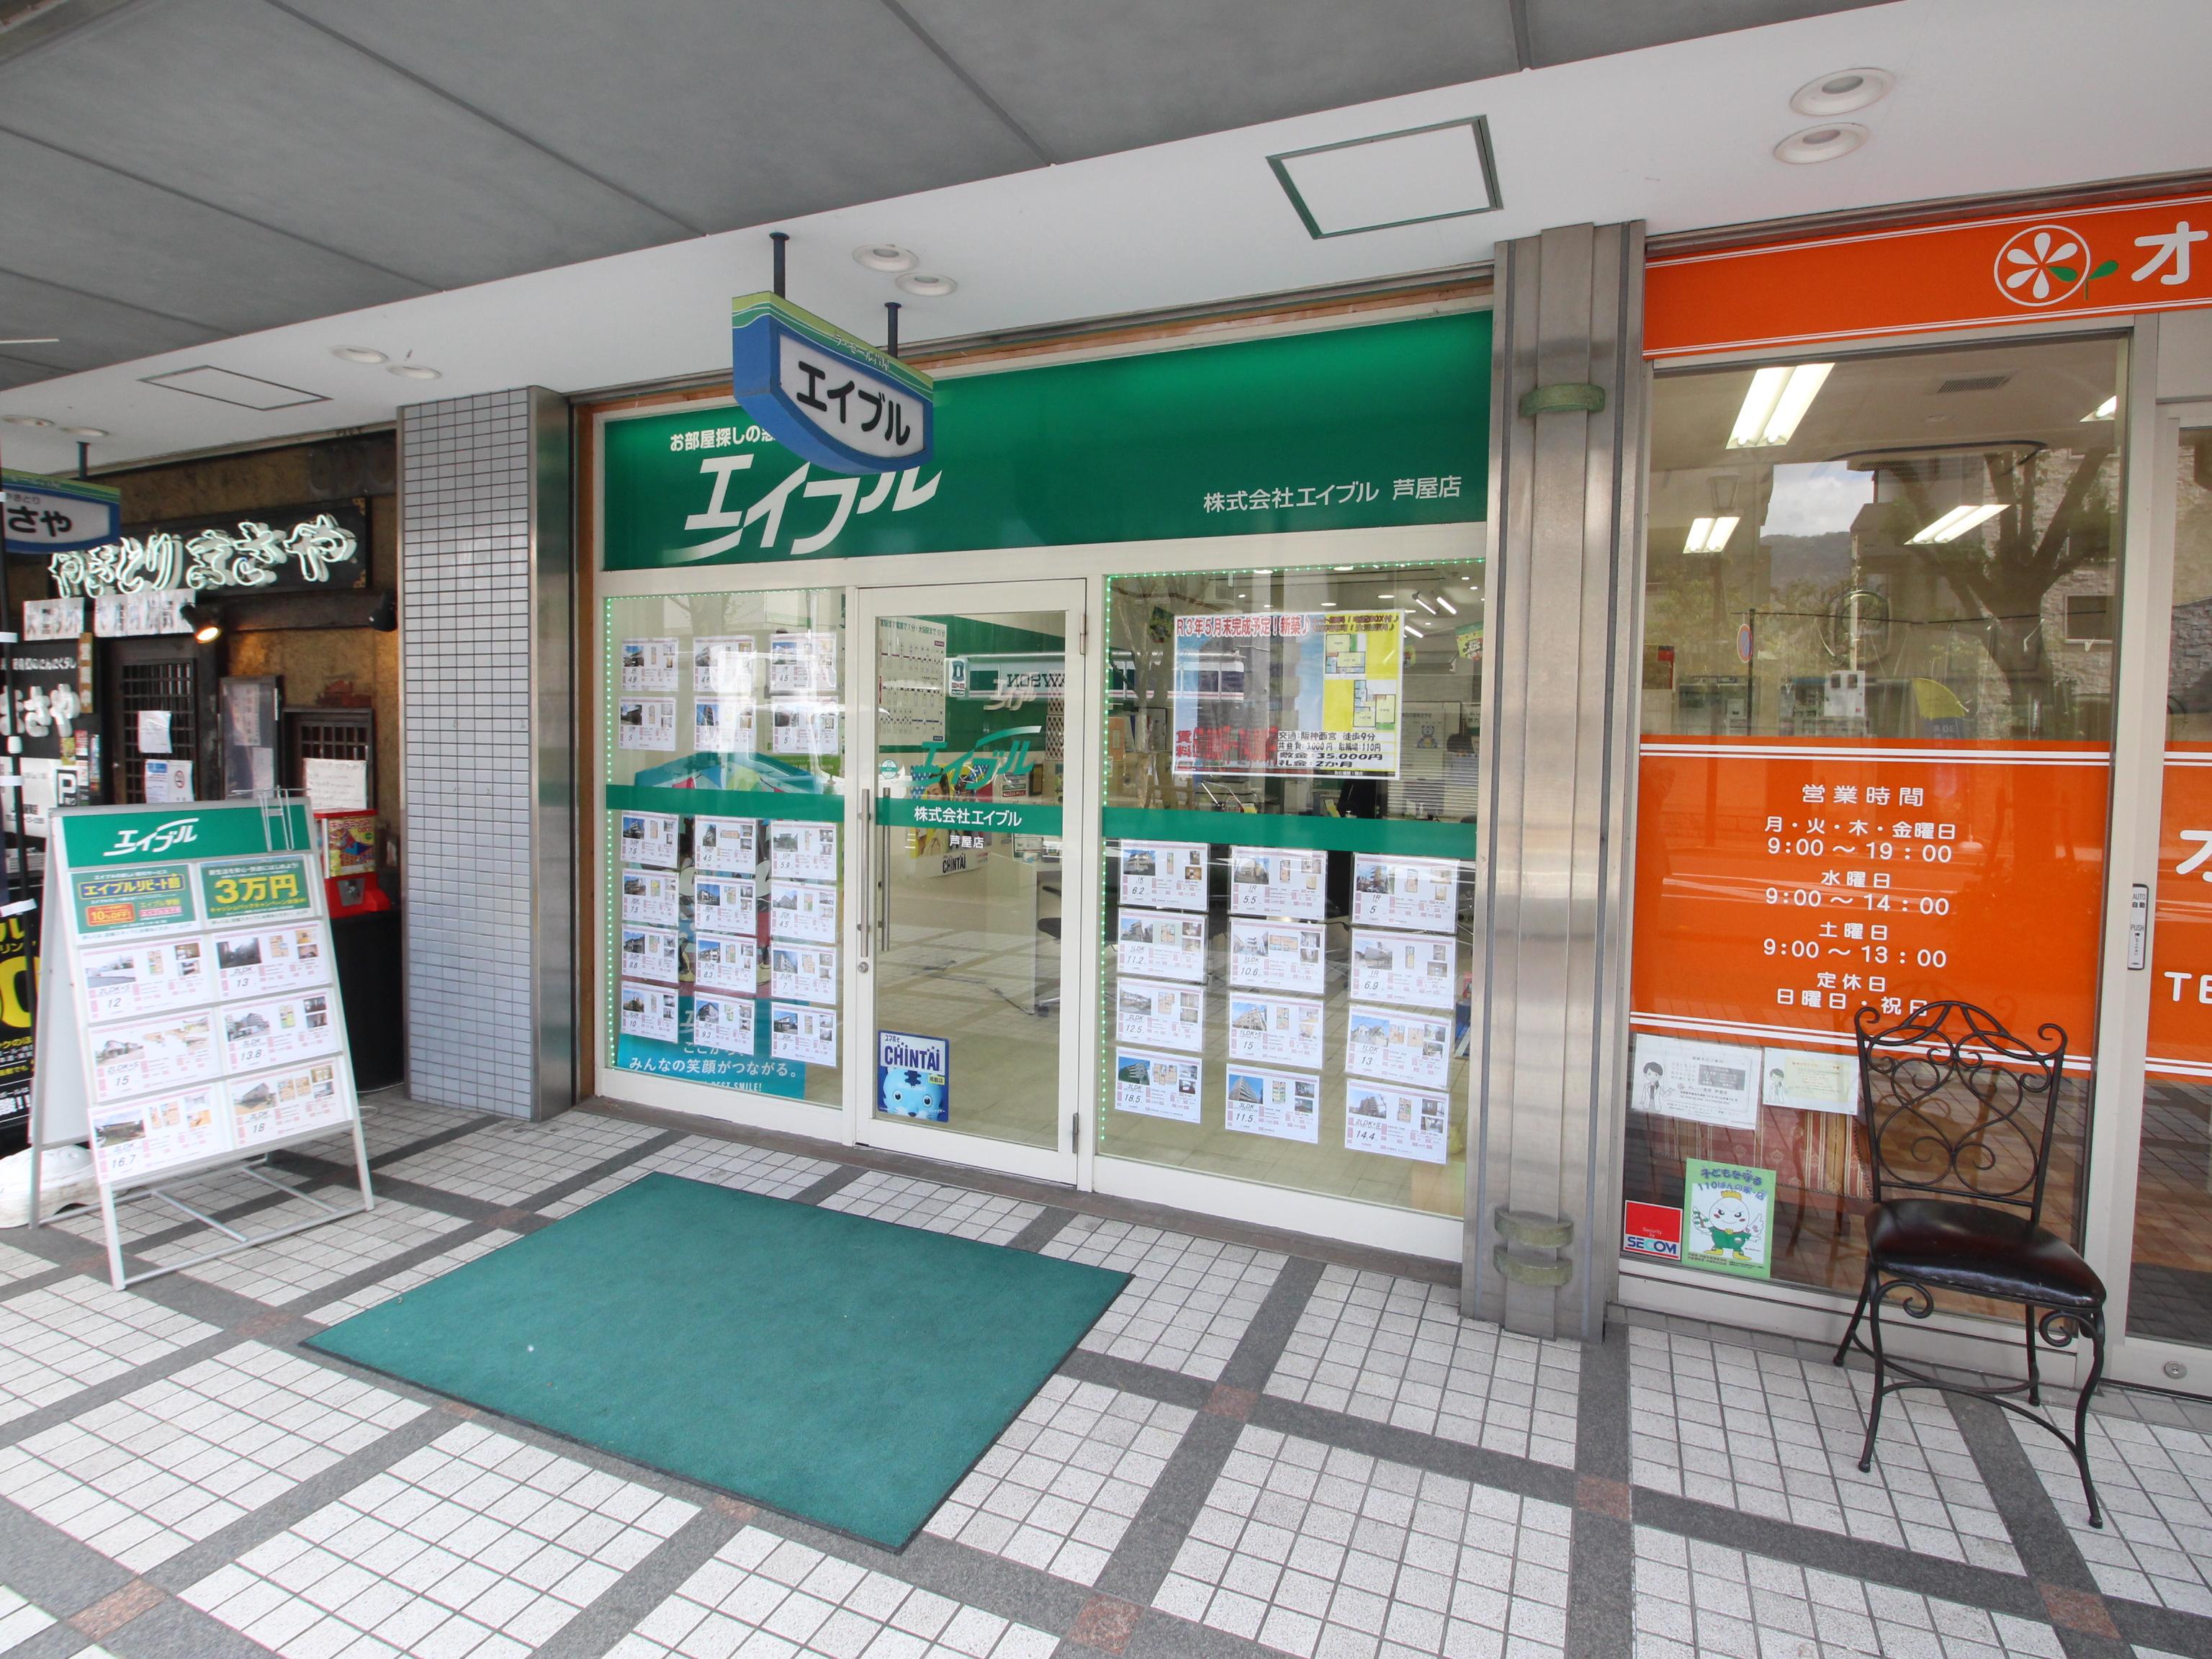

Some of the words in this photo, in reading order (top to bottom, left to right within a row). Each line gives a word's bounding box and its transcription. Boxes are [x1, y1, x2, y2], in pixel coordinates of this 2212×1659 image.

[2131, 221, 2208, 285] オ
[797, 360, 910, 446] エイブル
[1203, 481, 1380, 513] 株式会社エイブル
[1393, 475, 1462, 500] 芦屋店
[899, 725, 1042, 789] エイブル
[1802, 784, 1923, 807] 営業時間
[914, 806, 1022, 827] 株式会社エイブル
[1764, 816, 1956, 840] 月・火・木・金曜日
[102, 818, 199, 857] エイブル
[949, 835, 984, 849] 芦屋店
[943, 854, 966, 873] CHINTAI
[1821, 870, 1890, 888] 水曜日
[215, 873, 298, 904] 3万円
[1132, 886, 1145, 895] 6.2
[1243, 895, 1256, 904] 5.5
[1370, 905, 1377, 914] 5
[1819, 922, 1888, 941] 土曜日
[1241, 967, 1259, 976] 10.6
[237, 978, 249, 987] 13
[1364, 981, 1378, 990] 6.9
[1817, 972, 1886, 992] 定休日
[107, 997, 122, 1008] 12
[1125, 1024, 1143, 1033] 12.5
[1243, 1041, 1254, 1050] 15
[241, 1048, 262, 1061] 13.8
[884, 1042, 940, 1071] CHINTAI
[1361, 1056, 1372, 1065] 13
[629, 1057, 796, 1079] みんなの笑顔がつながる。
[115, 1075, 130, 1087] 15
[1124, 1094, 1141, 1103] 18.5
[1236, 1113, 1254, 1123] 11.5
[253, 1123, 266, 1133] 18
[1356, 1130, 1376, 1141] 14.4
[112, 1154, 137, 1169] 16.7
[1627, 1236, 1676, 1254] SECOM
